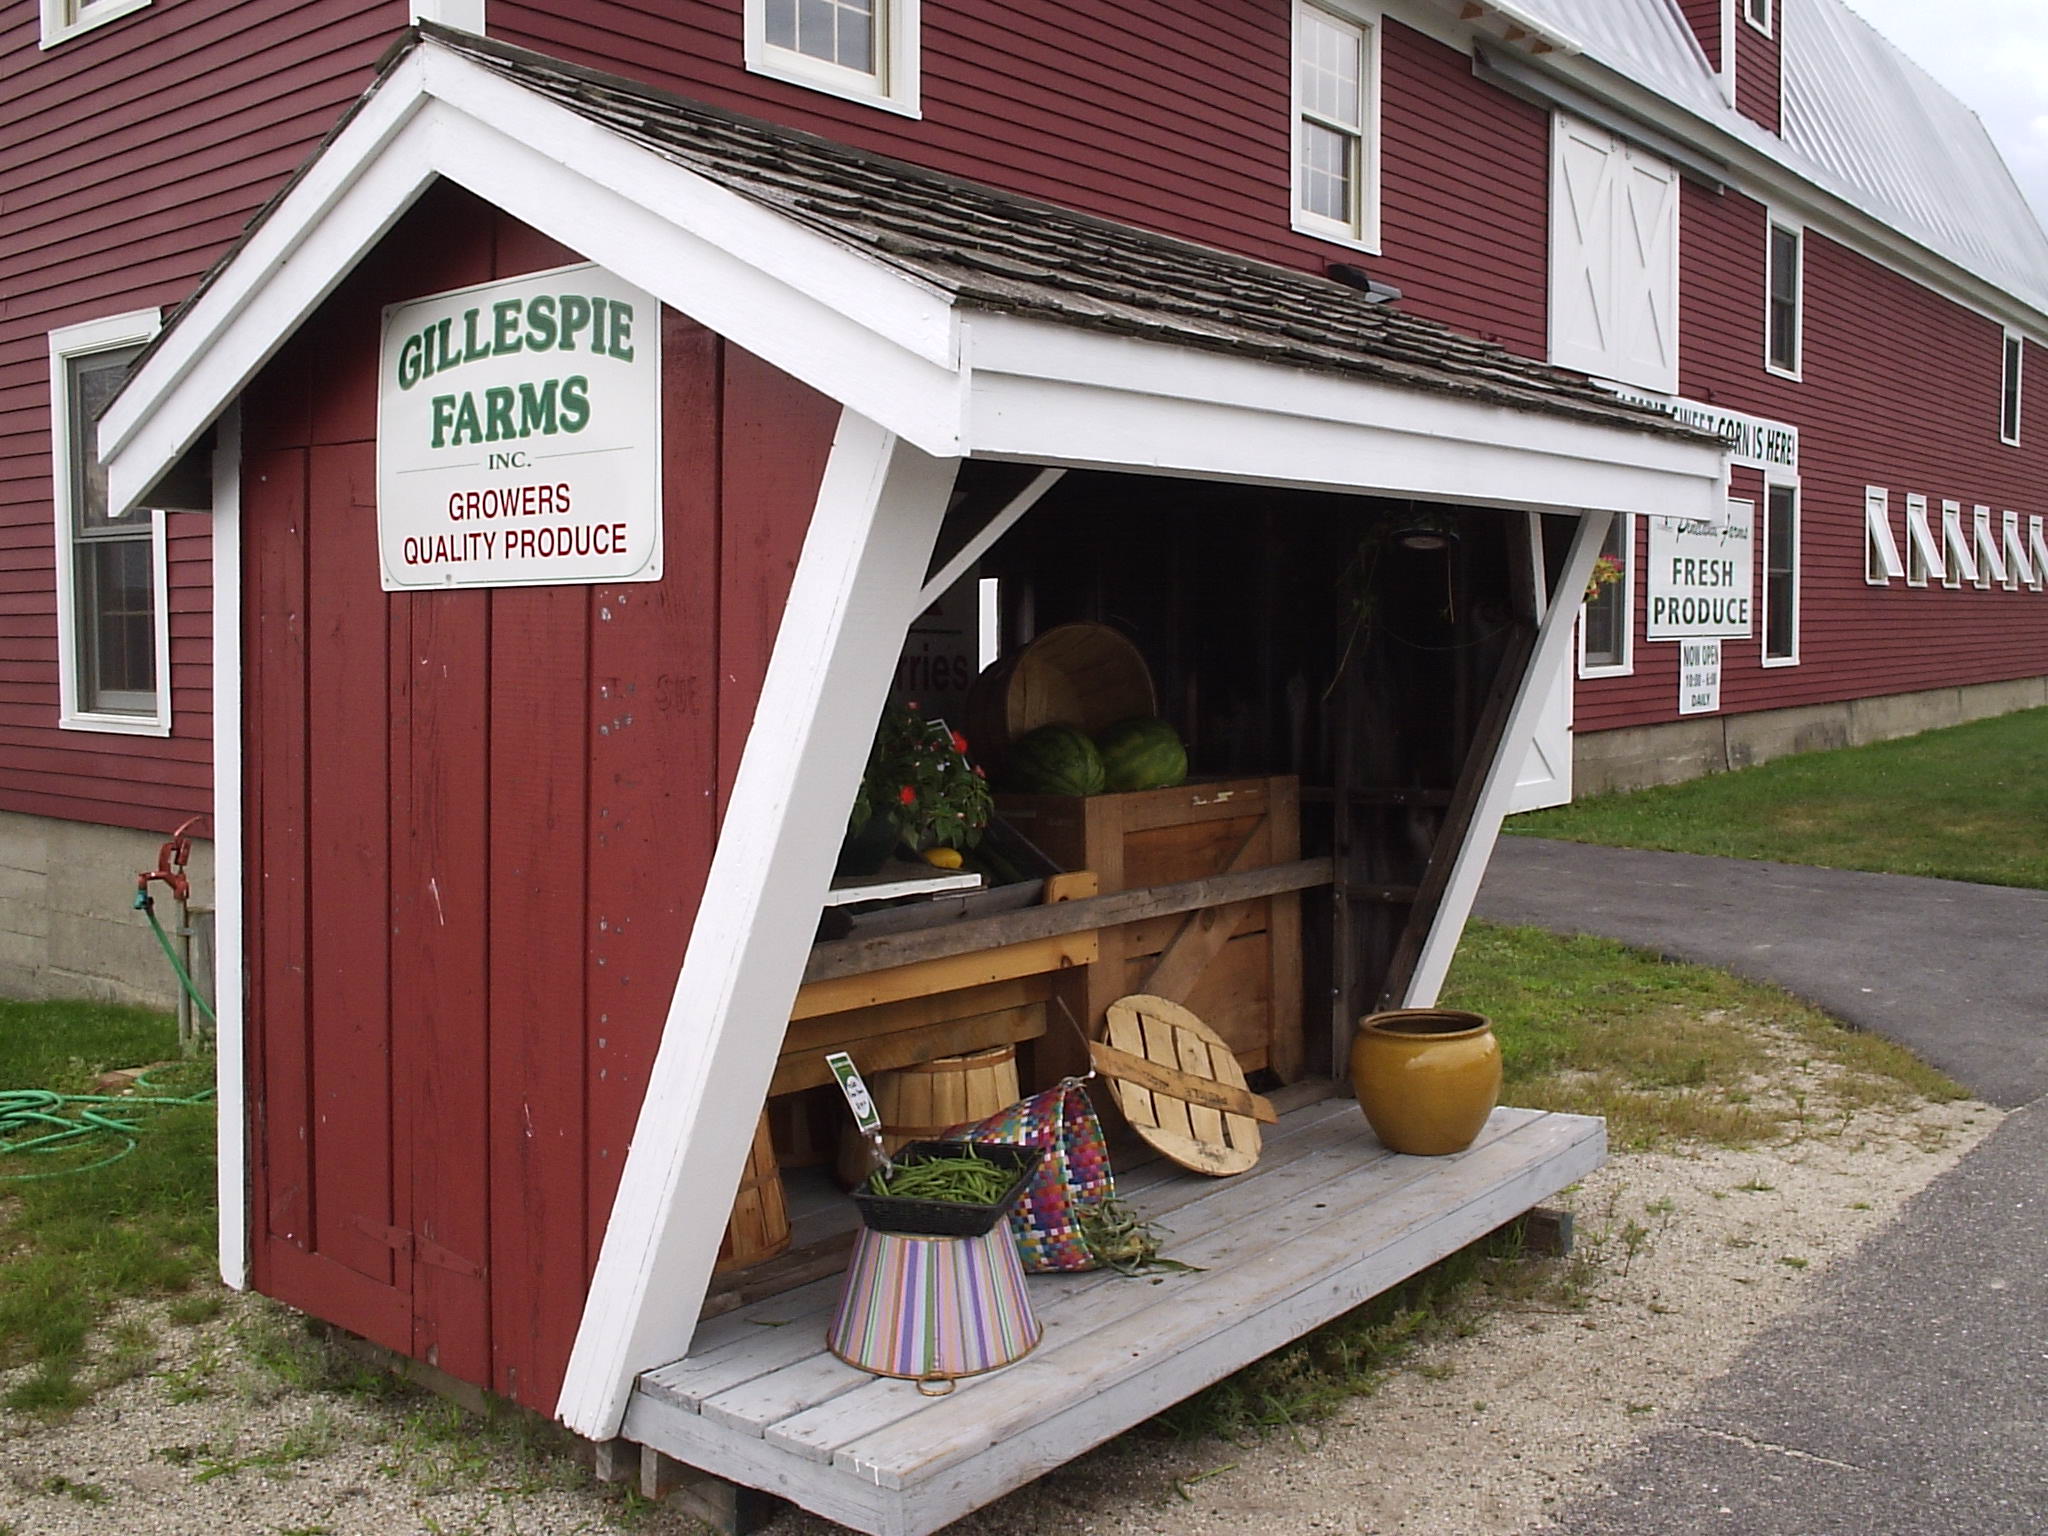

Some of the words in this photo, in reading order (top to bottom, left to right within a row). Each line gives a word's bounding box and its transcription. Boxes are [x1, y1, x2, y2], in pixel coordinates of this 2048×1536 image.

[398, 295, 634, 391] GILLESPIE
[431, 375, 590, 448] FARMS
[488, 452, 531, 470] INC.
[1752, 427, 1763, 460] IS
[1766, 428, 1796, 466] HERE!
[449, 483, 570, 521] GROWERS
[404, 532, 496, 565] QUALITY
[505, 523, 627, 559] PRODUCE
[1672, 557, 1733, 587] FRESH
[1653, 597, 1748, 625] PRODUCE
[1684, 645, 1700, 666] NOW
[1702, 645, 1719, 665] OPEN
[1692, 693, 1710, 707] DAILY
